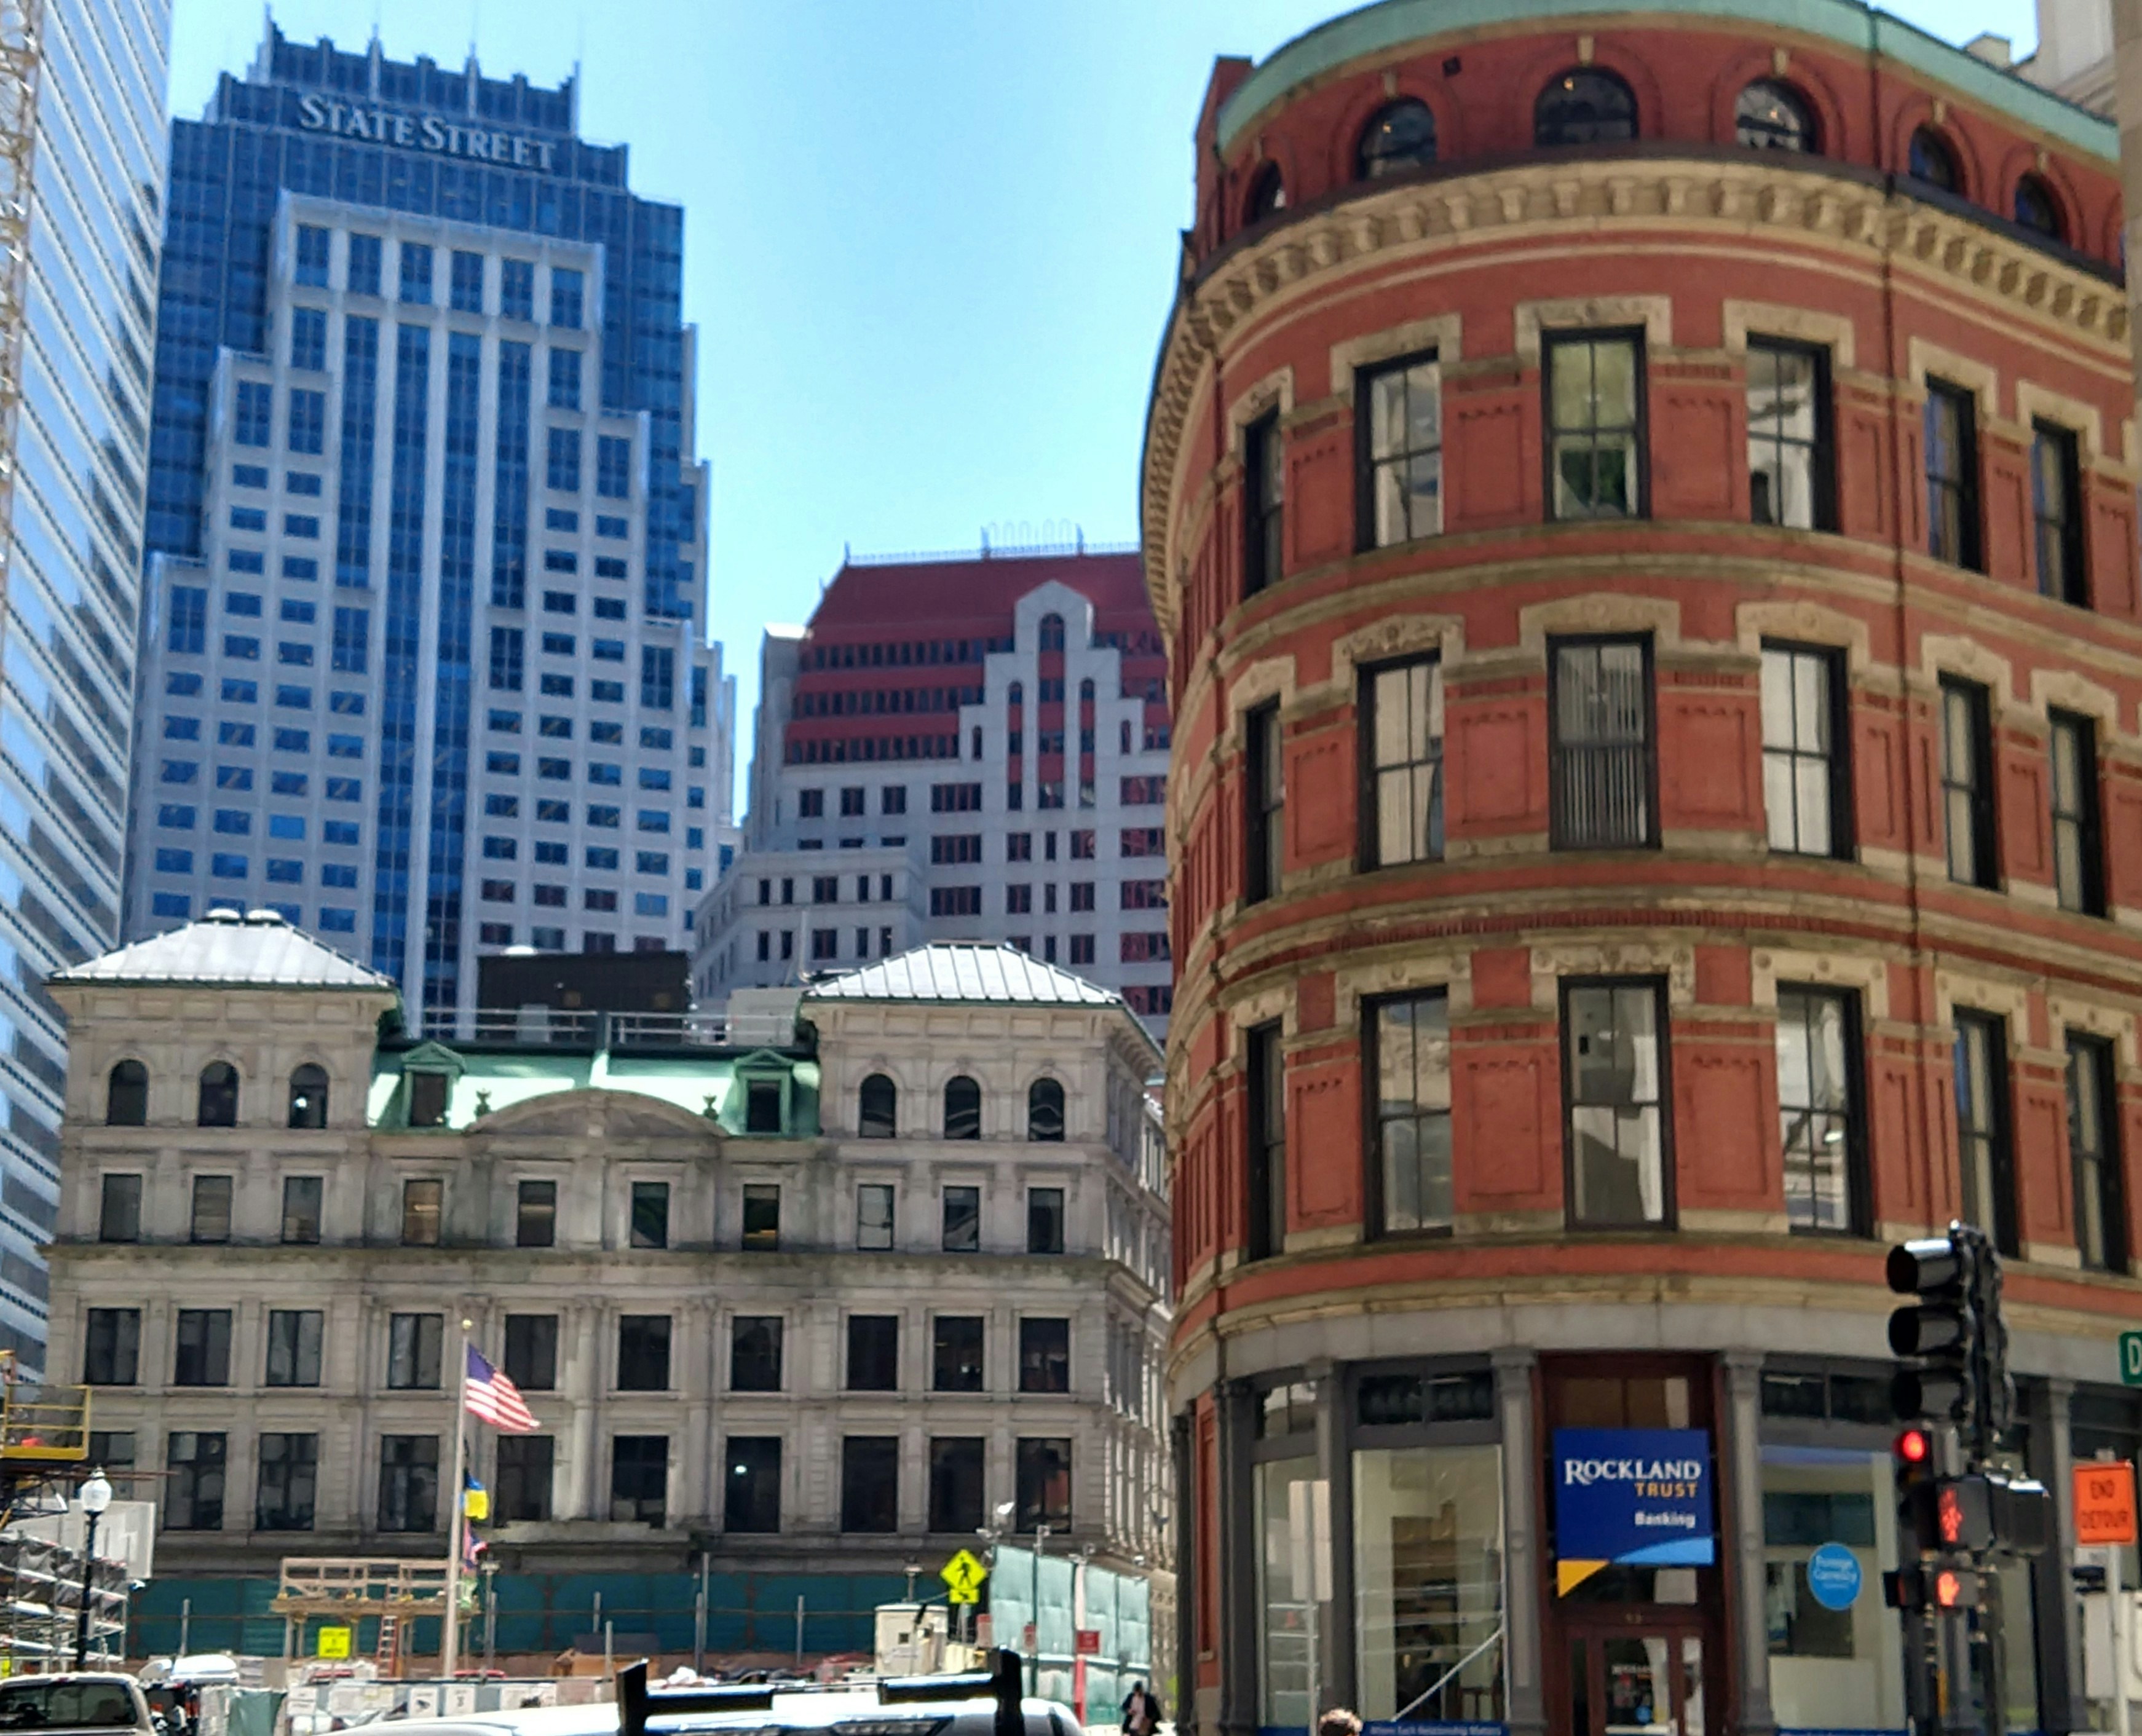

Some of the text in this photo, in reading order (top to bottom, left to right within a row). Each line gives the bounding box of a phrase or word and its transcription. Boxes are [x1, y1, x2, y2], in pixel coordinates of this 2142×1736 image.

[300, 93, 556, 169] STATE STREET
[1564, 1459, 1702, 1485] ROCKLAND
[1634, 1482, 1697, 1498] TRUST
[2090, 1480, 2115, 1500] END
[1634, 1510, 1696, 1529] Banking
[2079, 1510, 2129, 1529] DETOUR
